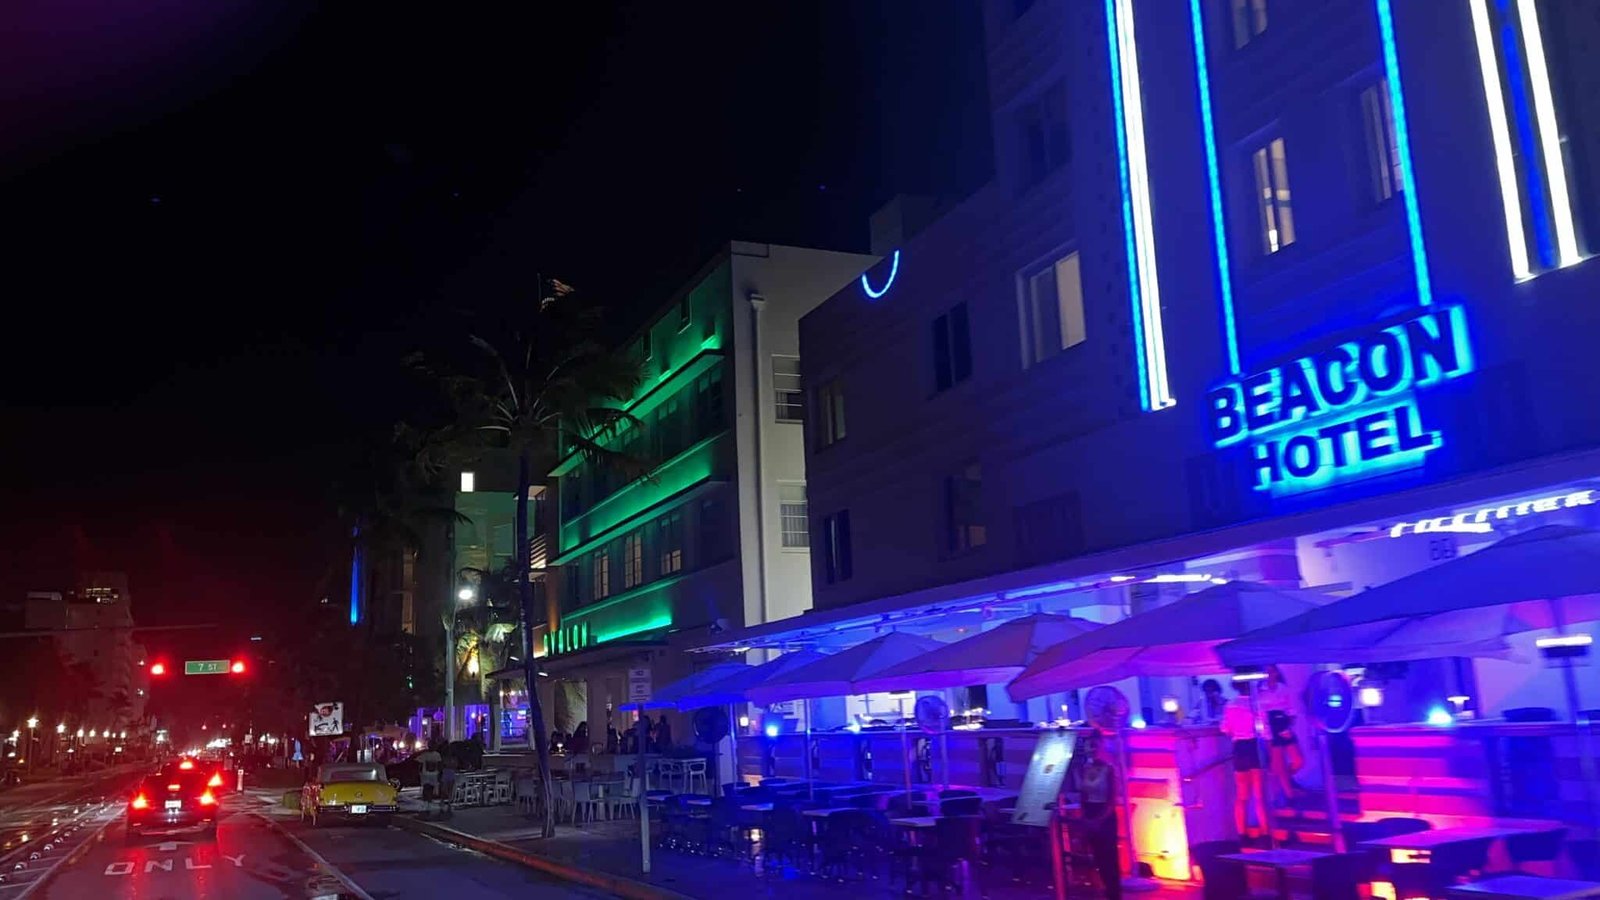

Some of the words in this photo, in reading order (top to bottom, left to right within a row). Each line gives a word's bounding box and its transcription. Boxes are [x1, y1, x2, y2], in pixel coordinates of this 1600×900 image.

[1206, 307, 1464, 446] BEACON
[1253, 404, 1437, 487] HOTEL
[543, 621, 587, 658] AVALON
[198, 663, 204, 672] 7
[208, 663, 217, 671] ST
[104, 854, 246, 875] ONLY
